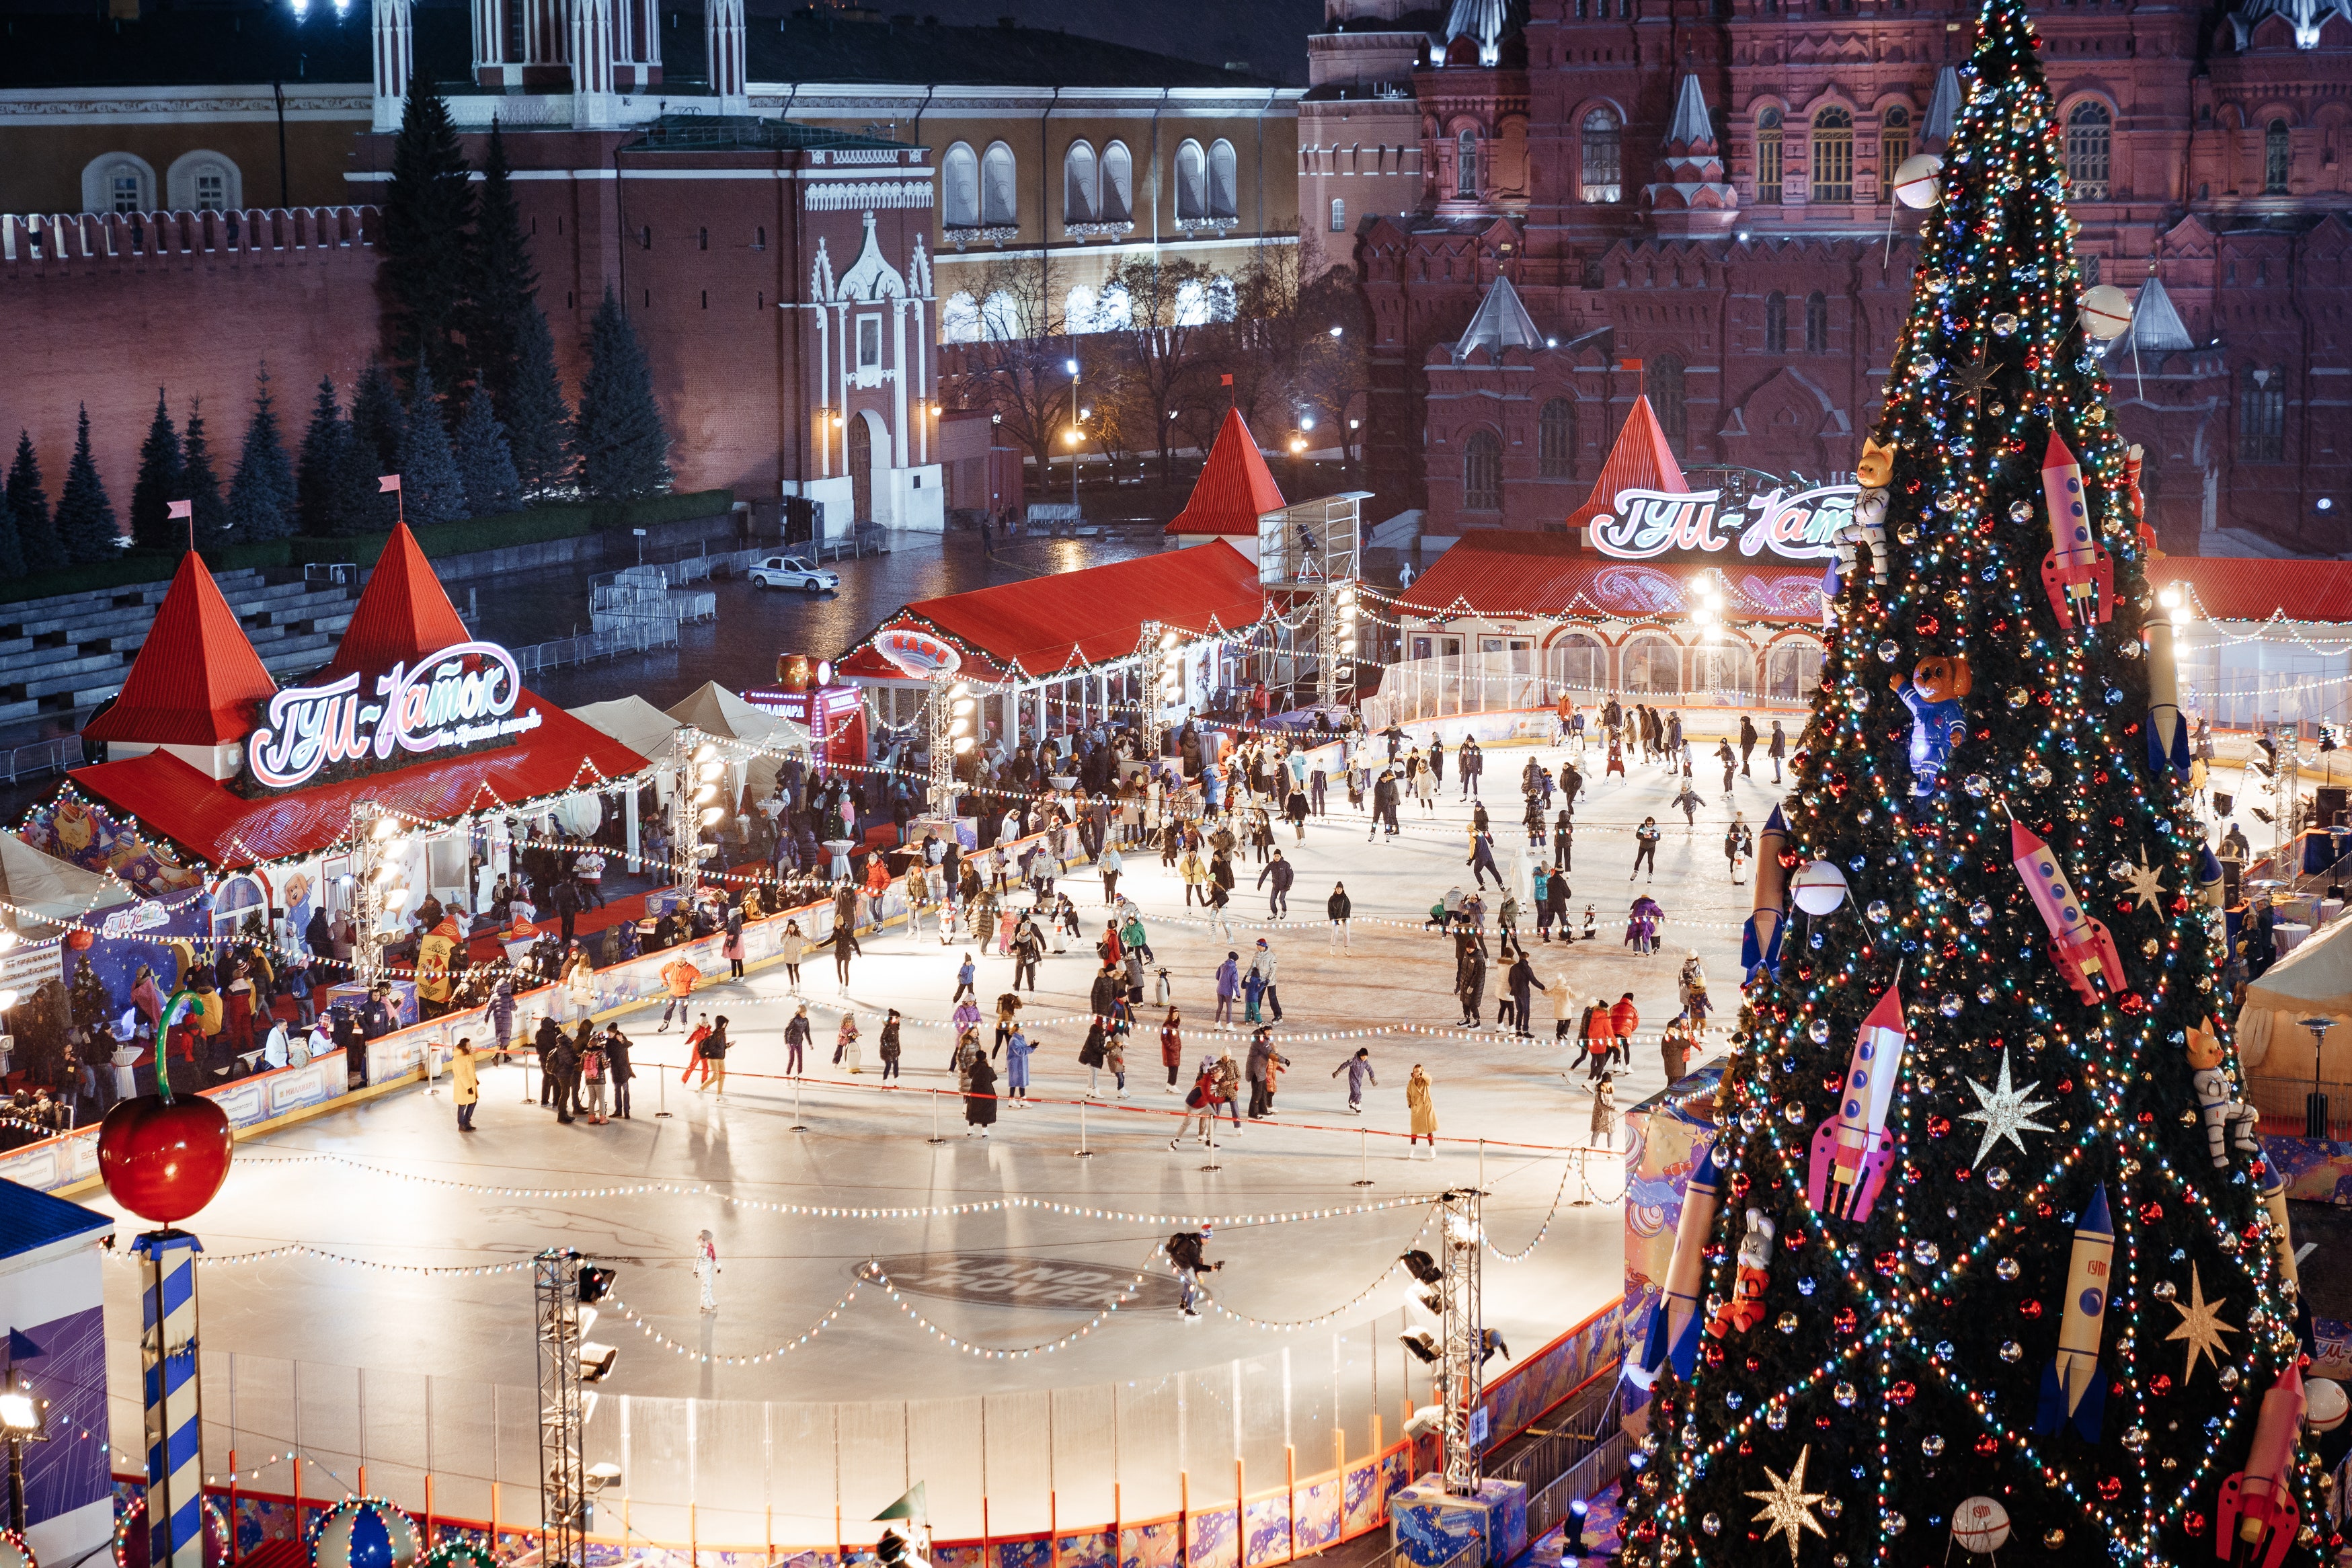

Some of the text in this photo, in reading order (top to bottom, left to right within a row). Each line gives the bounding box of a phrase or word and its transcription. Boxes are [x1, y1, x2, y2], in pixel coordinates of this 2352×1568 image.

[893, 634, 949, 665] КАФЕ
[828, 695, 856, 709] МИЛЛИАРД
[285, 1081, 316, 1097] МИЛЛИАРД
[227, 1101, 253, 1114] mastercard
[18, 1167, 48, 1181] mastercard
[928, 1259, 1114, 1286] LAND
[918, 1274, 1141, 1304] ROVER
